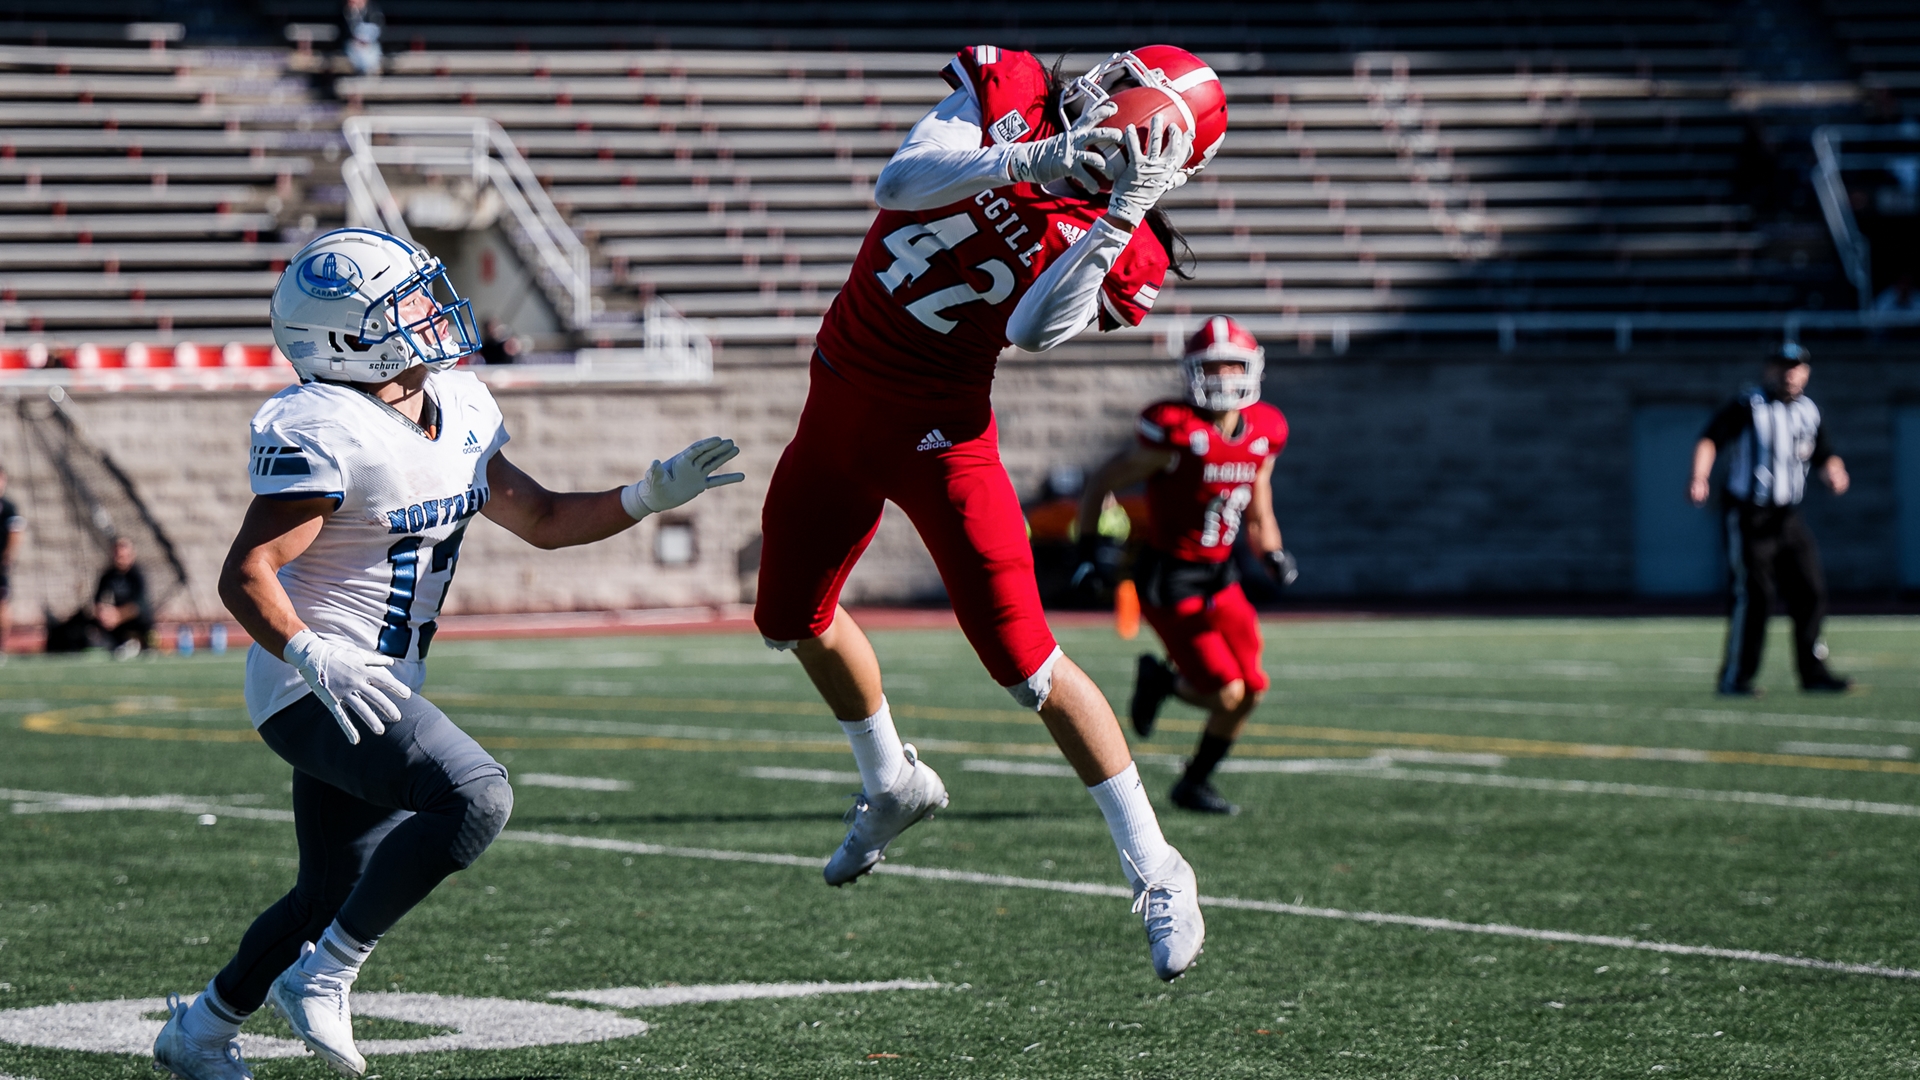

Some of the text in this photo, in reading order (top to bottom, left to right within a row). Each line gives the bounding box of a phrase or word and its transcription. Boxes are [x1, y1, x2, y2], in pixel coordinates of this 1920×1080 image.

[873, 211, 1016, 335] 42
[368, 361, 400, 371] schutt
[916, 440, 953, 452] adidas
